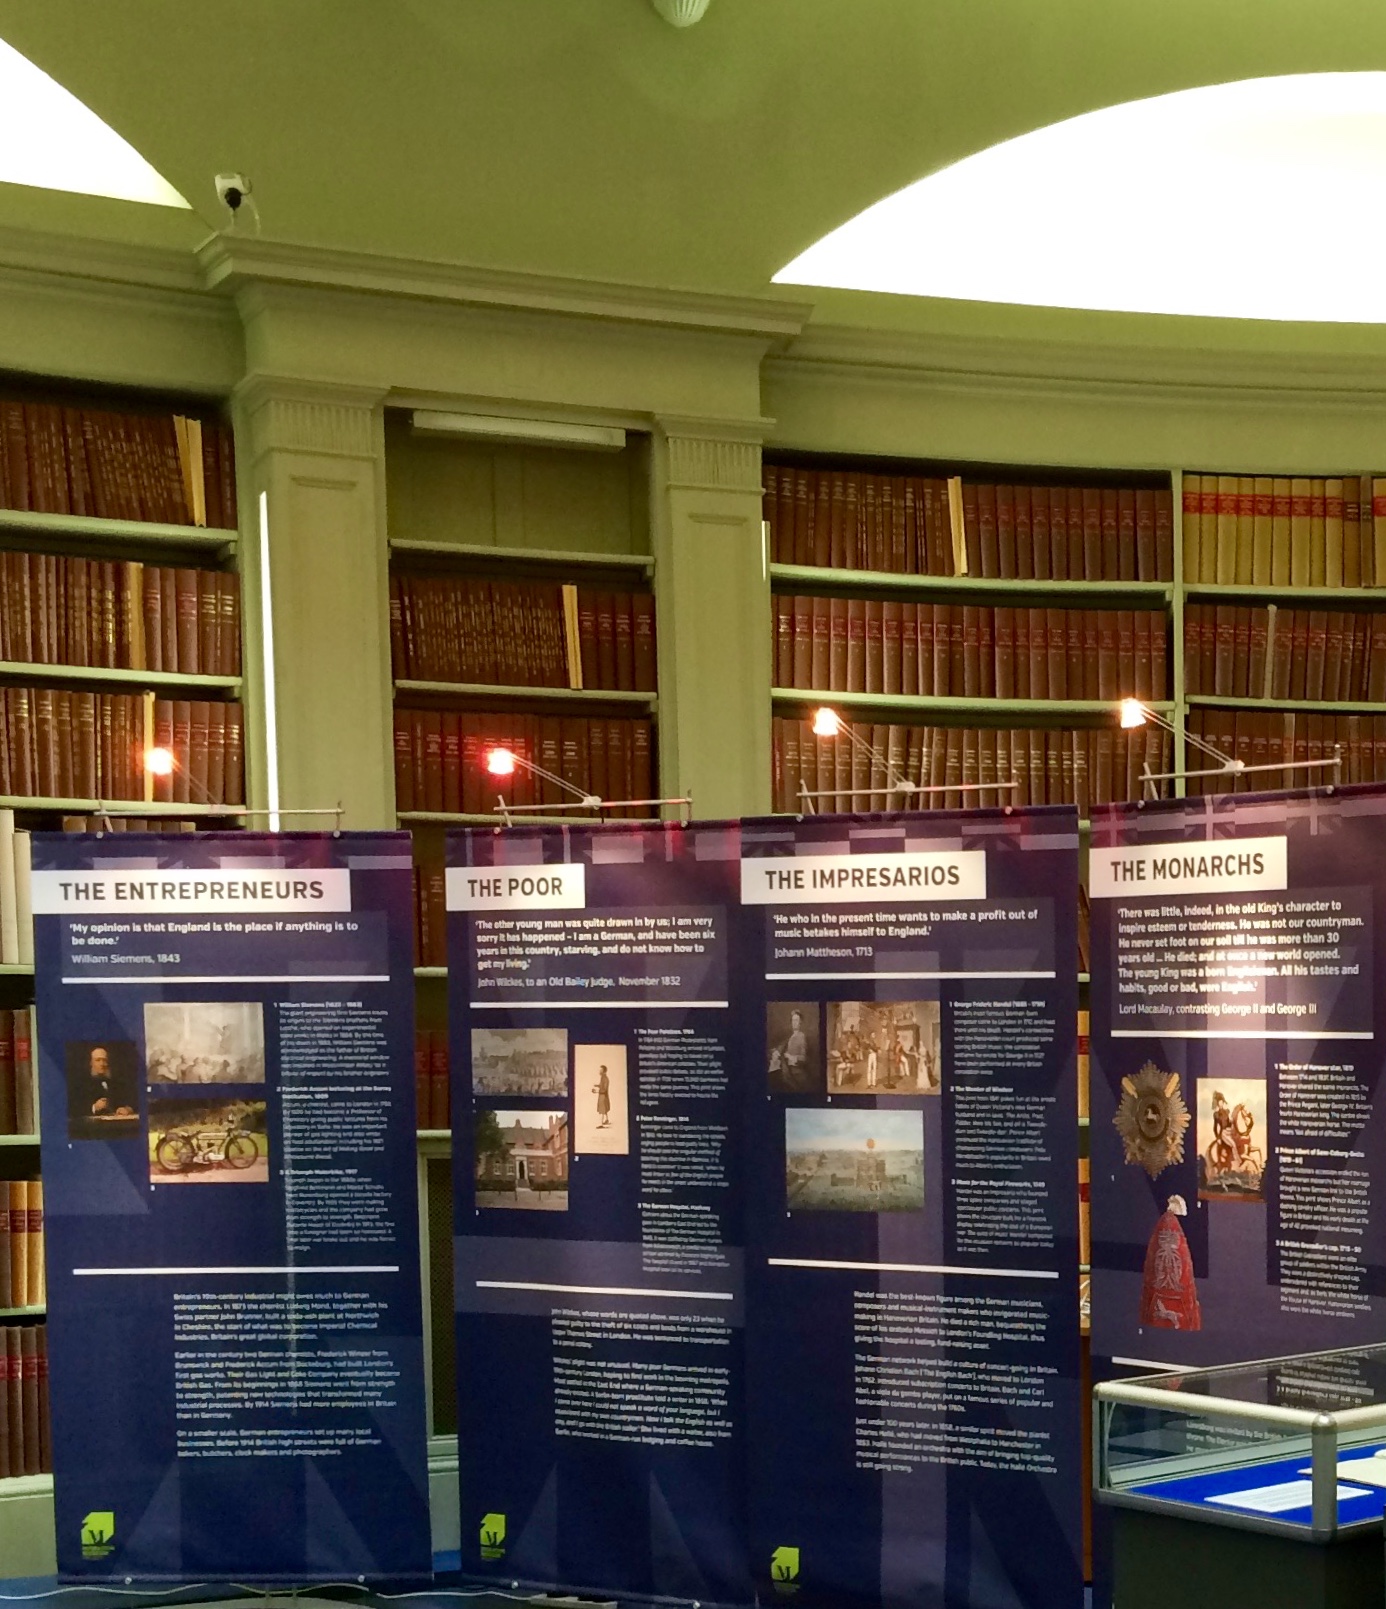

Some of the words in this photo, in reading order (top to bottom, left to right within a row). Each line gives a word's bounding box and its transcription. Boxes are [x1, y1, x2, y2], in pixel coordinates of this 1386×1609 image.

[1111, 860, 1146, 882] THE
[1152, 853, 1264, 880] MONARCHS
[765, 870, 805, 889] THE
[812, 866, 960, 888] IMPRESARIOS
[59, 882, 105, 900] THE
[114, 881, 324, 900] ENTREPRENEURS
[467, 878, 503, 897] THE
[507, 877, 563, 896] POOR
[493, 920, 514, 929] other
[515, 921, 543, 930] young
[582, 919, 605, 929] quite
[606, 918, 633, 927] drawn
[634, 918, 643, 927] in
[644, 918, 655, 929] by
[672, 918, 676, 926] I
[693, 919, 713, 928] very
[789, 914, 809, 923] who
[810, 914, 820, 923] in
[821, 914, 837, 923] the
[838, 913, 874, 924] present
[875, 912, 897, 922] time
[898, 912, 928, 921] wants
[929, 912, 941, 921] to
[942, 911, 968, 921] make
[977, 910, 1007, 922] profit
[1008, 910, 1026, 920] out
[1027, 910, 1038, 919] of
[90, 923, 131, 934] opinion
[132, 923, 142, 932] is
[143, 923, 166, 932] that
[167, 923, 211, 934] England
[212, 923, 222, 932] is
[223, 923, 243, 931] the
[244, 923, 274, 934] place
[275, 922, 283, 931] if
[285, 922, 333, 933] anything
[334, 922, 345, 931] is
[346, 922, 359, 931] to
[774, 928, 801, 937] music
[802, 927, 839, 937] betakes
[840, 927, 874, 937] himself
[875, 927, 887, 936] to
[71, 936, 86, 945] be
